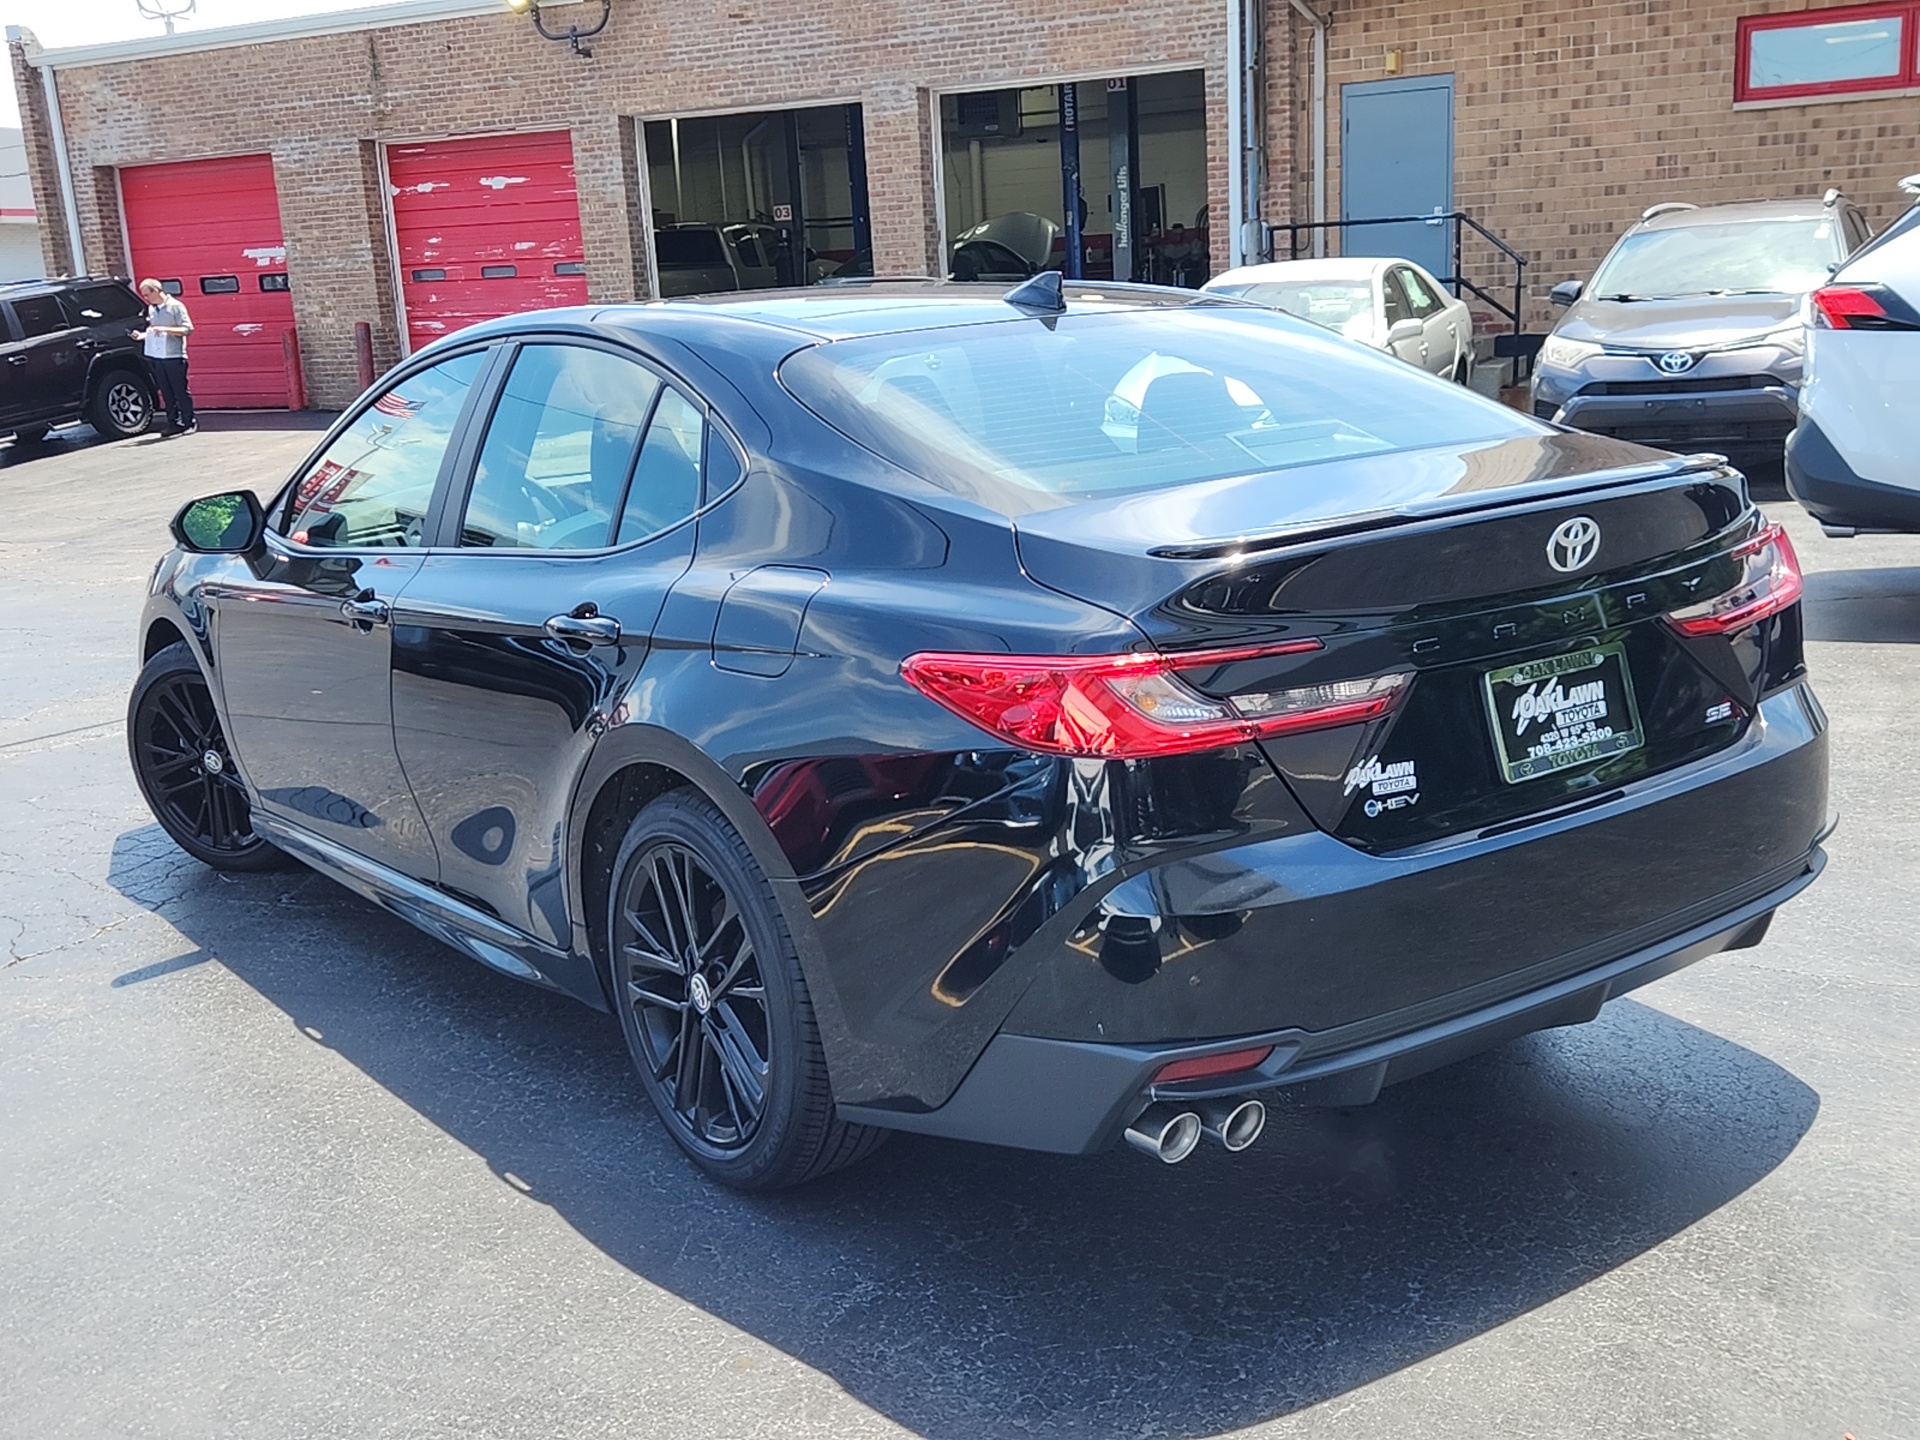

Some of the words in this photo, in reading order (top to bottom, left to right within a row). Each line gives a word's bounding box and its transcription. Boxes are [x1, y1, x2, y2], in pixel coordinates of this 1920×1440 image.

[1107, 78, 1126, 90] 01
[1063, 83, 1076, 126] ROTAR
[774, 207, 791, 219] 03
[1115, 190, 1130, 249] hallenger
[1412, 576, 1702, 654] CAMRY
[1522, 661, 1551, 680] OAK
[1553, 652, 1592, 673] LAWN
[1562, 703, 1602, 723] TOYOTA
[1704, 701, 1732, 723] SE
[1527, 726, 1613, 759] 708-423-5200
[1549, 743, 1602, 767] TOYOTA
[1377, 778, 1411, 791] TOYOTA
